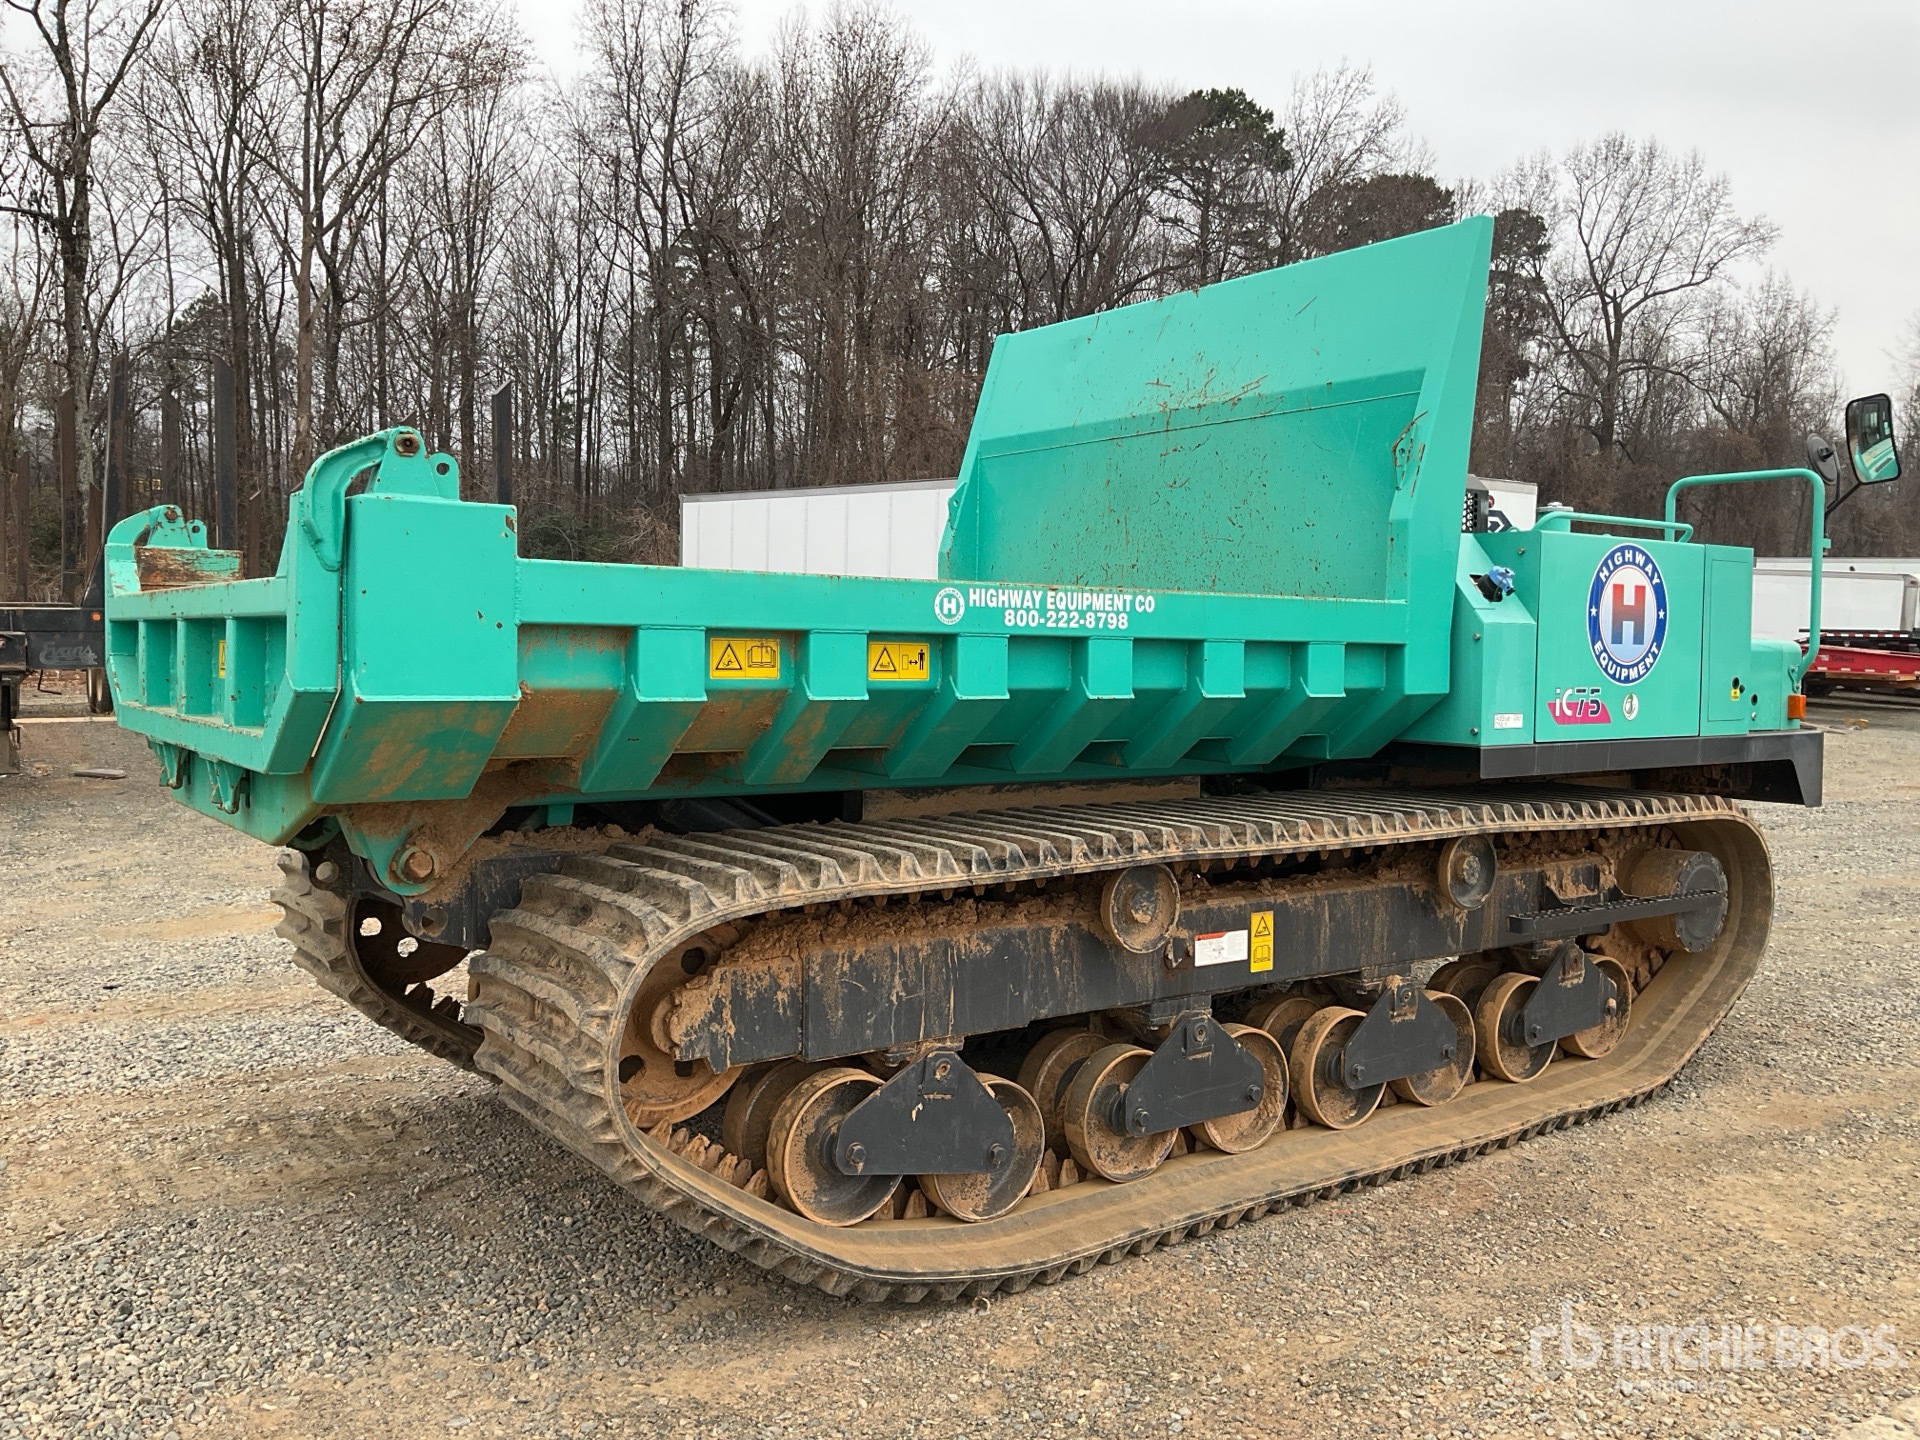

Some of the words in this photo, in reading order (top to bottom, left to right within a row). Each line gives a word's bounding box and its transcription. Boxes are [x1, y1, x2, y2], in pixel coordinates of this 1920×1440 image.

[1599, 549, 1661, 583] HIGHWAY
[943, 597, 957, 615] H
[968, 588, 1043, 610] HIGHWAY
[1047, 591, 1132, 612] EQUIPMENT
[1135, 595, 1155, 613] CO
[1611, 583, 1646, 645] H
[1004, 609, 1129, 630] 800-222-8798
[1594, 641, 1660, 681] EQUIPMENT
